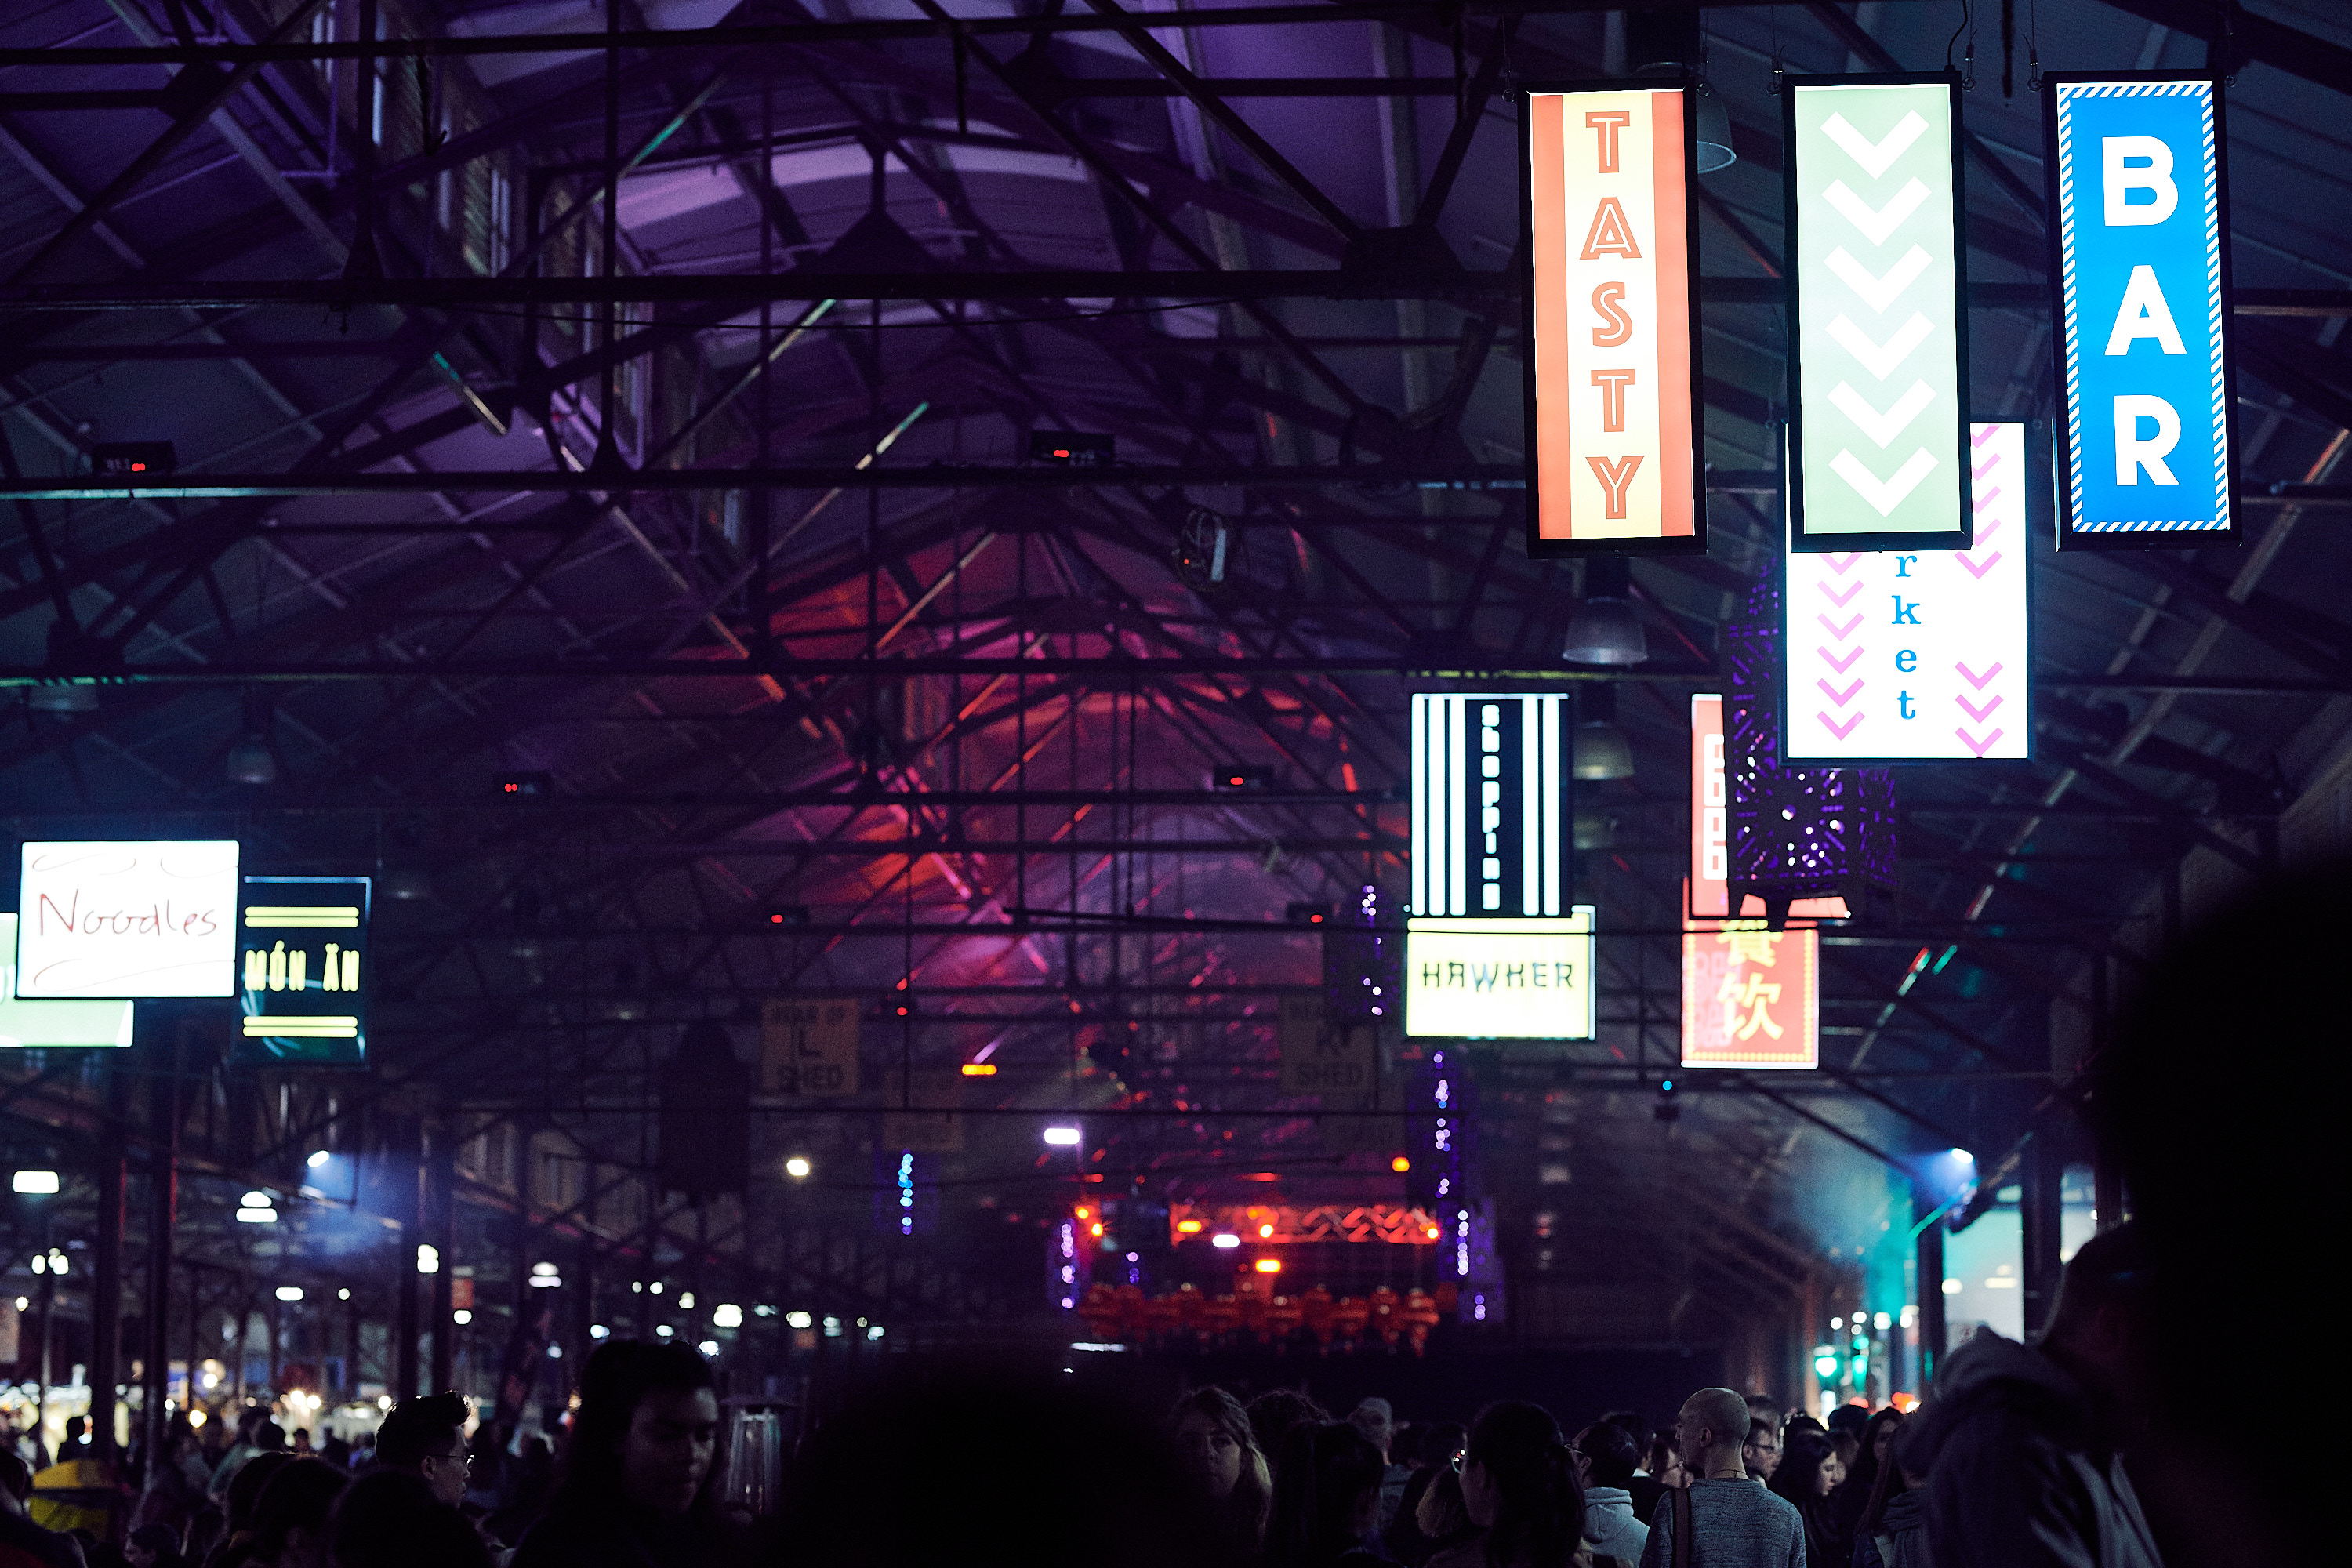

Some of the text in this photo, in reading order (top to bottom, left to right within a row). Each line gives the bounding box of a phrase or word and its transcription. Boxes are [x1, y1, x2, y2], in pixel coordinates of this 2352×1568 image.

[1580, 111, 1644, 519] TASTY
[2102, 136, 2187, 486] BAR
[1891, 554, 1921, 720] rket
[40, 888, 216, 936] Noodles
[1423, 961, 1573, 993] HAWKER
[798, 1029, 822, 1057] L
